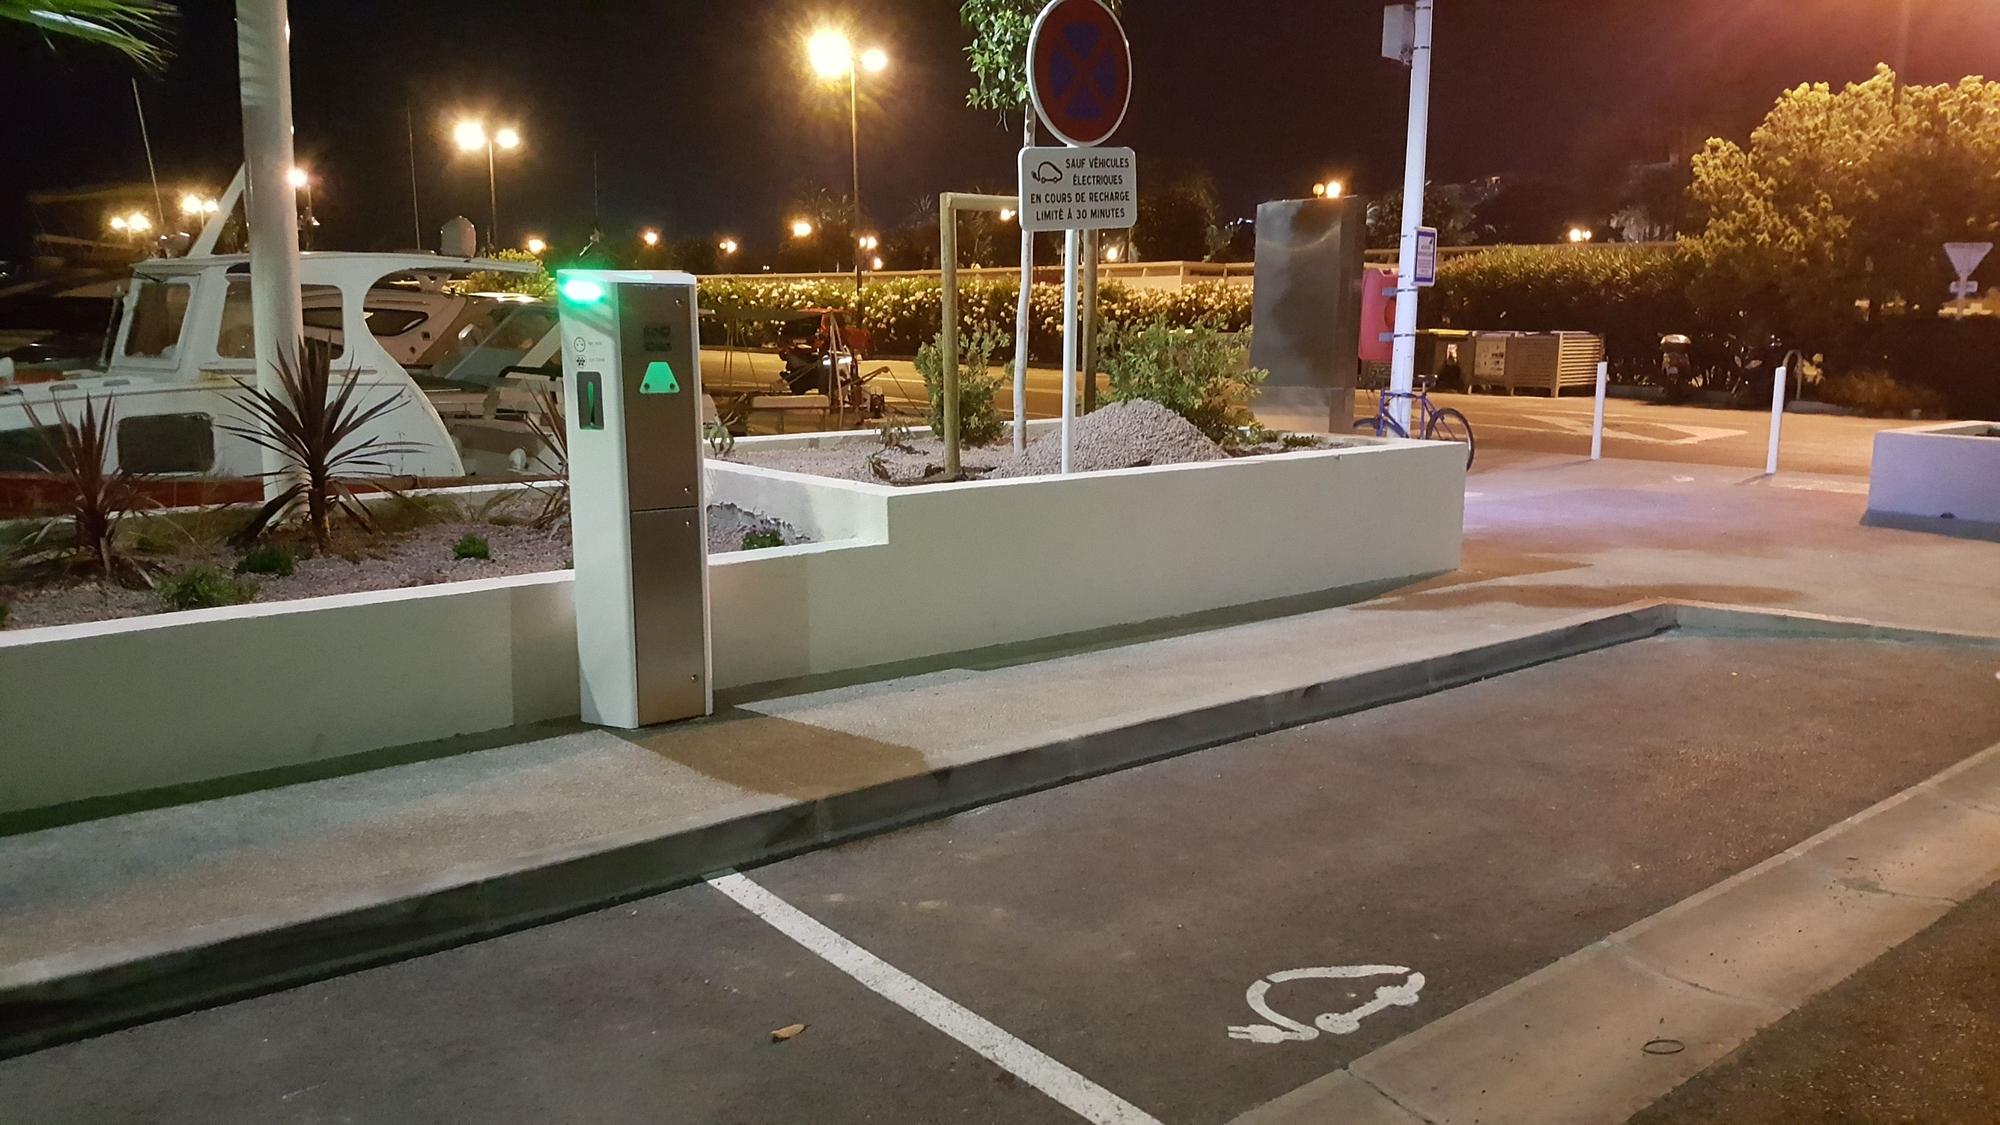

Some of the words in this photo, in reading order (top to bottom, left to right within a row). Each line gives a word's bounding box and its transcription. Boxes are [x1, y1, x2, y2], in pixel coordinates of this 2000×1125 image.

[1065, 158, 1086, 169] SAUF
[1088, 156, 1130, 169] VÉHICULES
[1072, 174, 1123, 186] ÉLECTRIQUES
[1030, 193, 1042, 204] EN
[1045, 192, 1072, 204] COURS
[1075, 192, 1086, 203] DE
[1089, 191, 1130, 203] RECHARGE
[1036, 208, 1064, 221] LIMITÉ
[1067, 208, 1073, 220] À
[1076, 209, 1087, 220] 30
[1090, 208, 1125, 219] MINUTES
